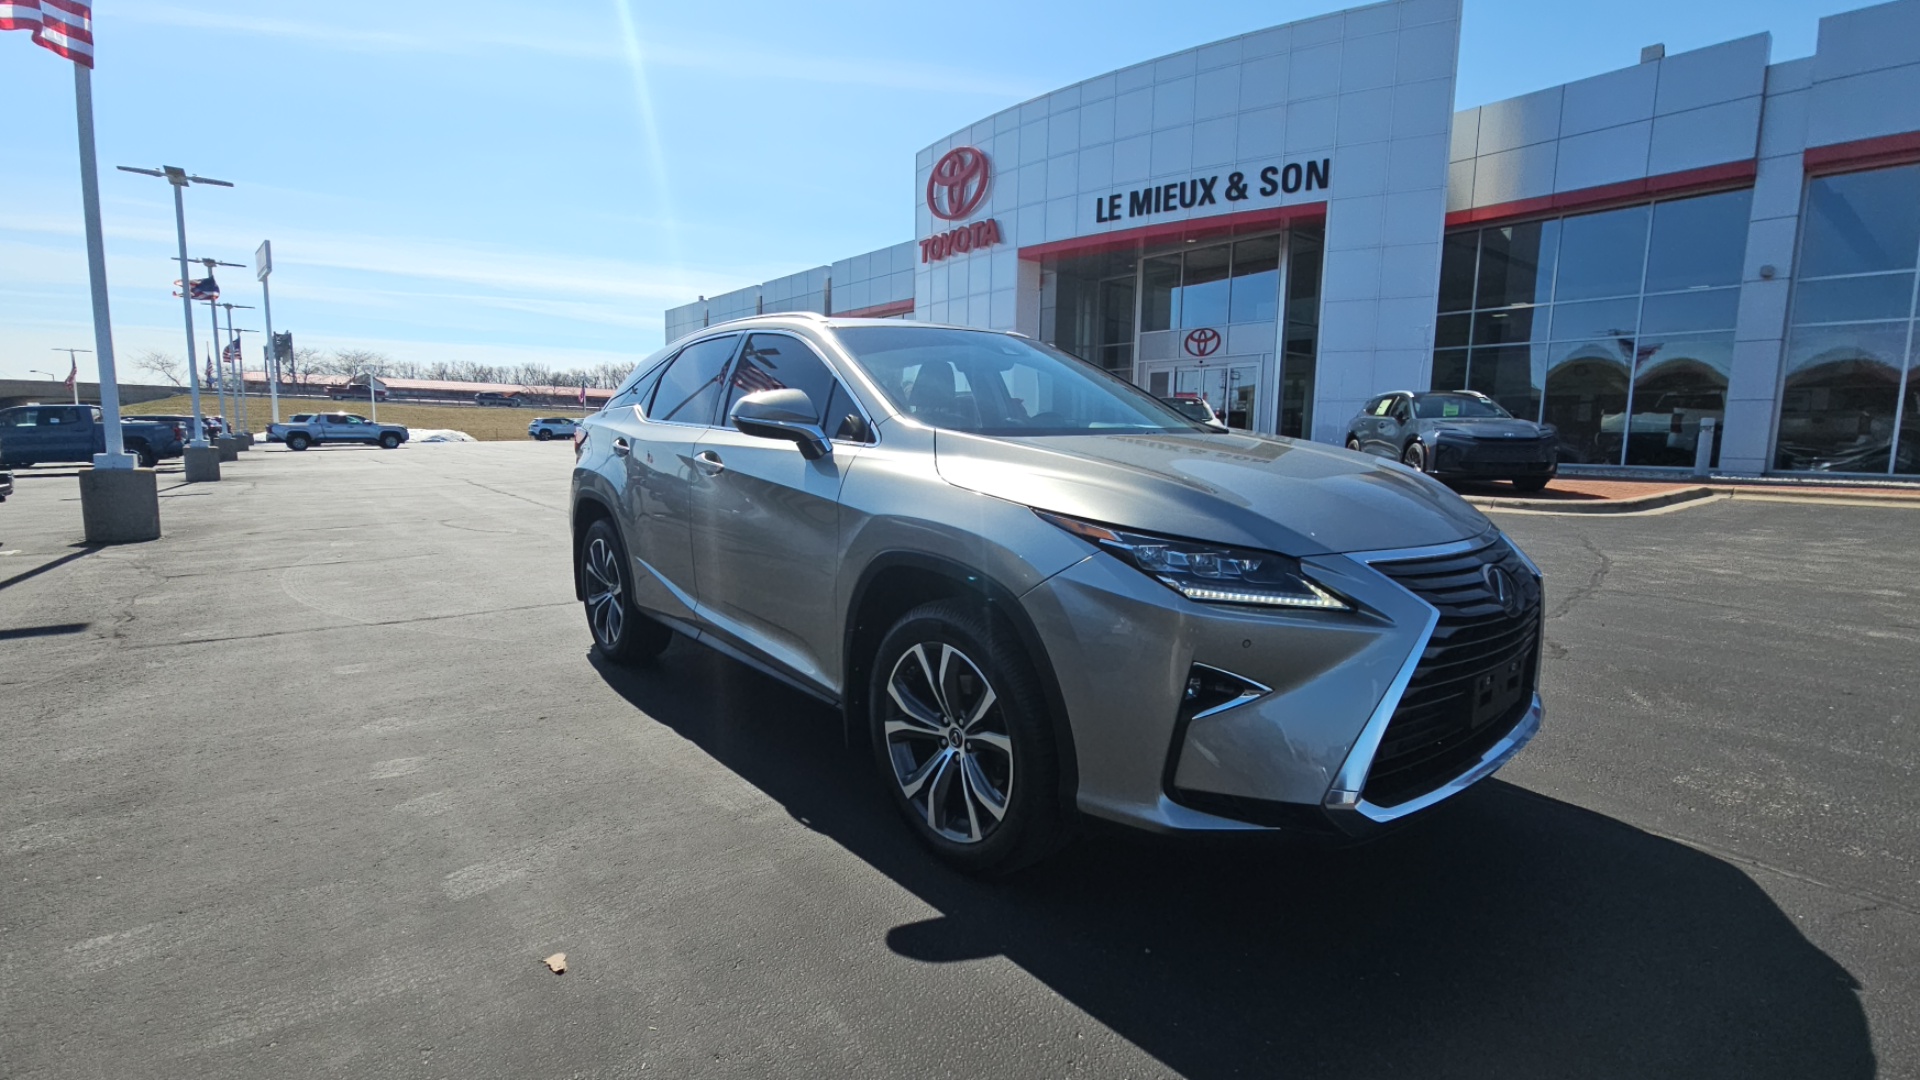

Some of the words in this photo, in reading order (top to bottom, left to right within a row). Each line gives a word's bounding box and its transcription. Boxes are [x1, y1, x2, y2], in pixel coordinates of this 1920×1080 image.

[1096, 194, 1122, 223] LE
[1129, 176, 1218, 218] MIEUX
[1225, 171, 1249, 202] &
[1260, 158, 1330, 196] SON
[919, 218, 1000, 264] TOYOTA
